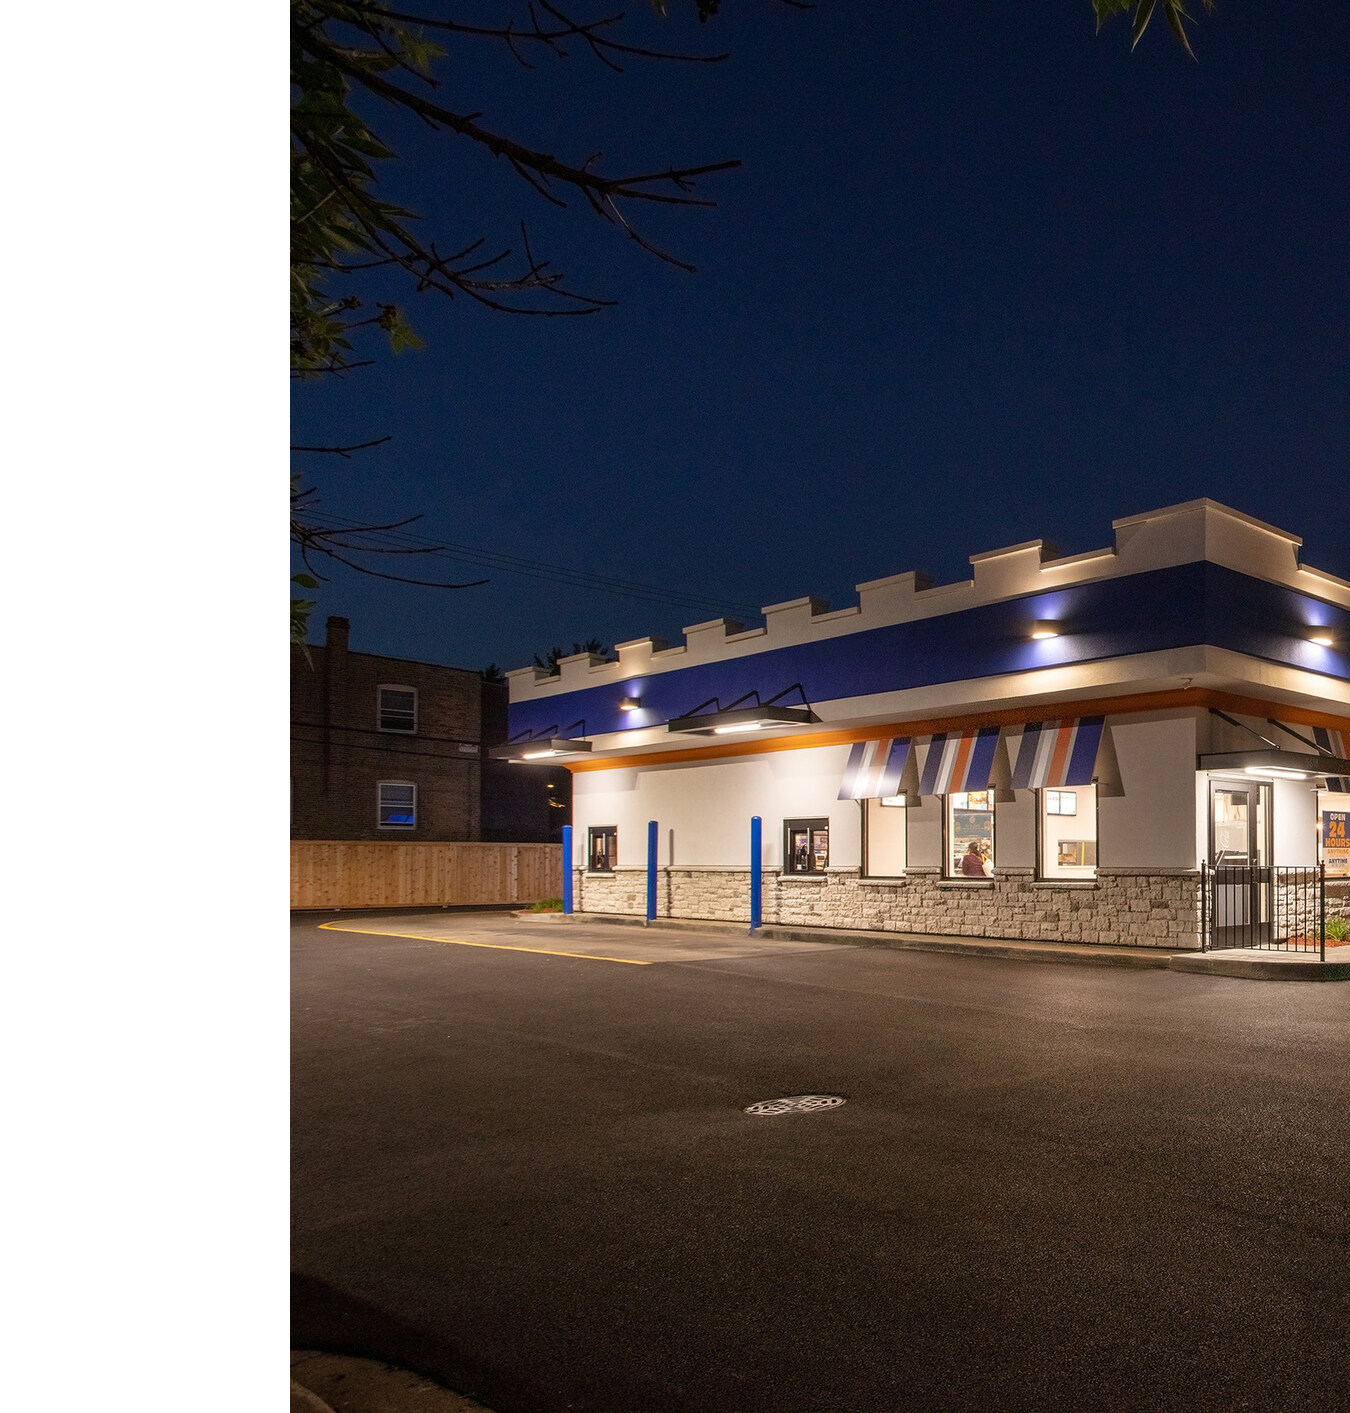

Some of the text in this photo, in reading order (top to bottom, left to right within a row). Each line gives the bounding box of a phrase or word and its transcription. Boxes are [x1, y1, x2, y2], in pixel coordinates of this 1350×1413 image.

[1330, 813, 1346, 821] OPEN
[1329, 821, 1345, 837] 24
[1325, 838, 1350, 847] HOURS
